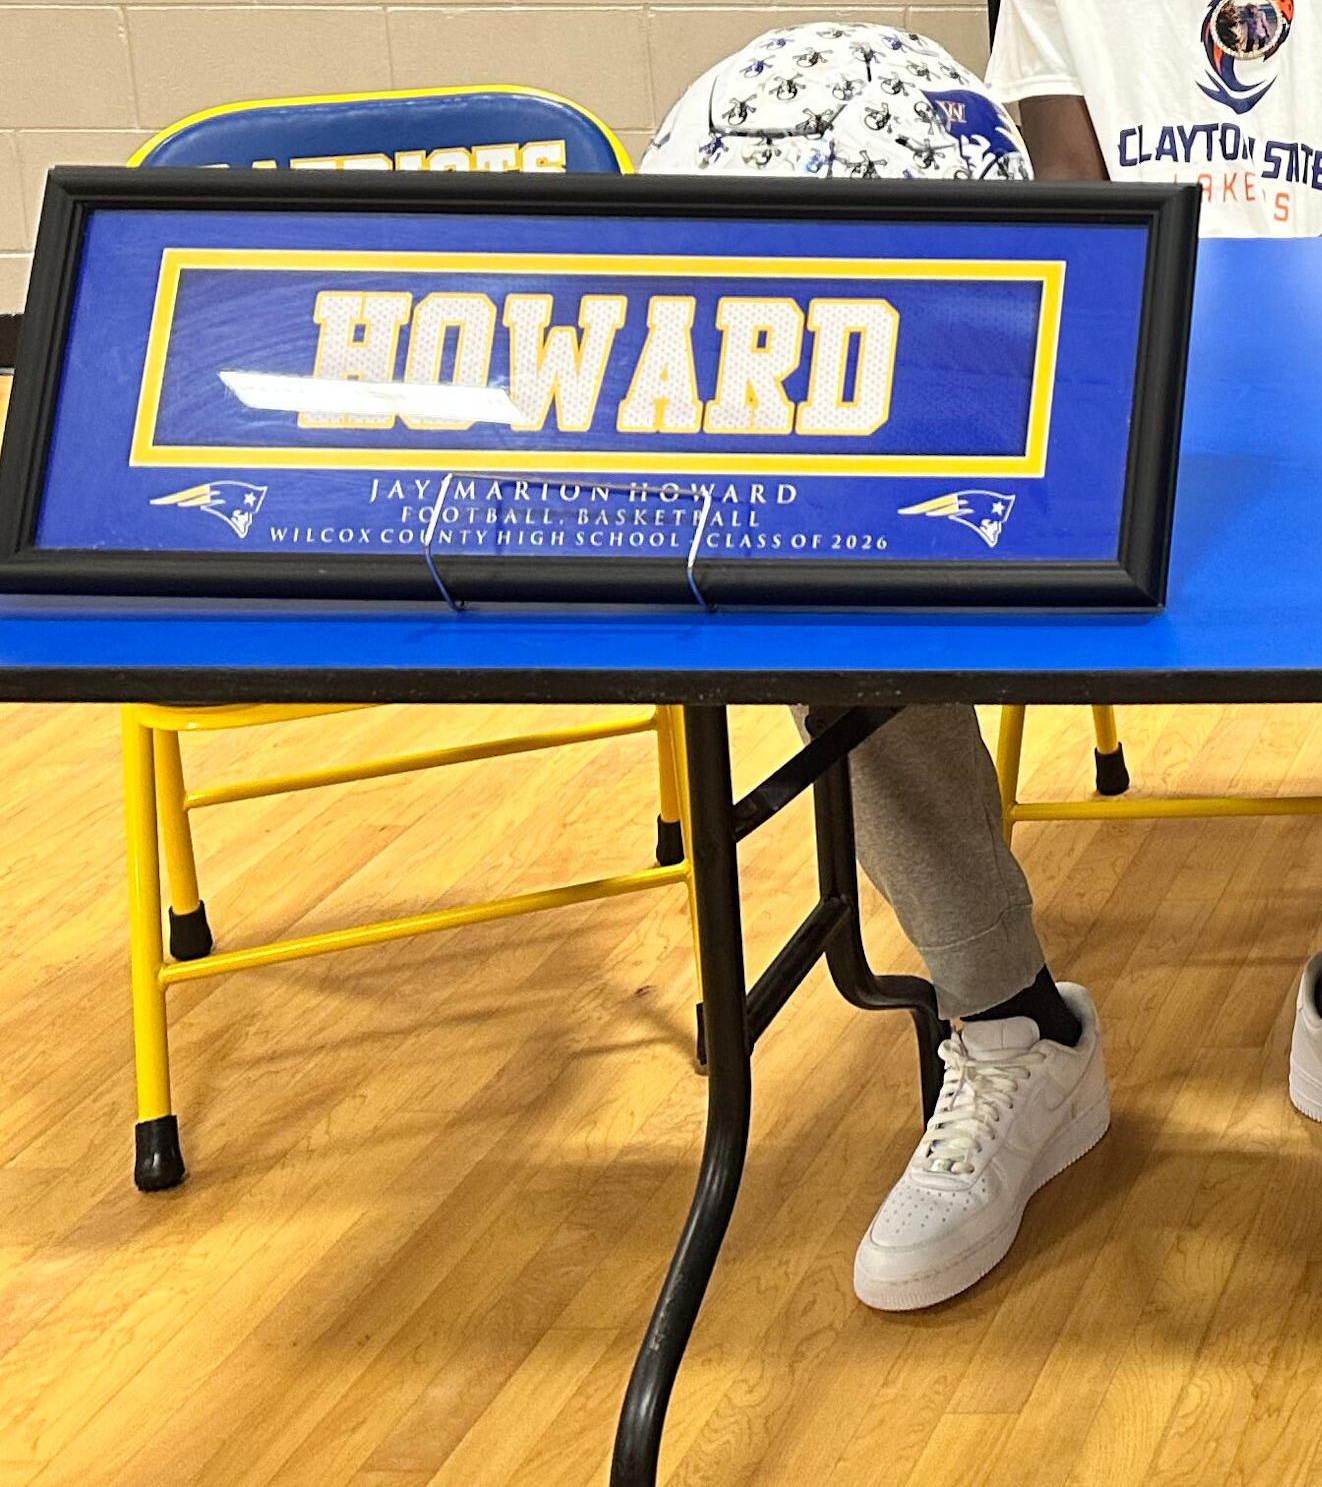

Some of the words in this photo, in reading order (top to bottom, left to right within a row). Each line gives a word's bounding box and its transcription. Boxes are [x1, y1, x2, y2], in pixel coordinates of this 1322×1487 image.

[297, 290, 899, 435] HOWARD
[628, 481, 798, 505] HOWARD
[269, 527, 372, 544] WILCOX
[497, 530, 564, 546] HIGH
[575, 531, 680, 547] SCHOOL
[706, 532, 782, 549] CLASS
[791, 534, 822, 549] OF
[831, 535, 888, 550] 2026
